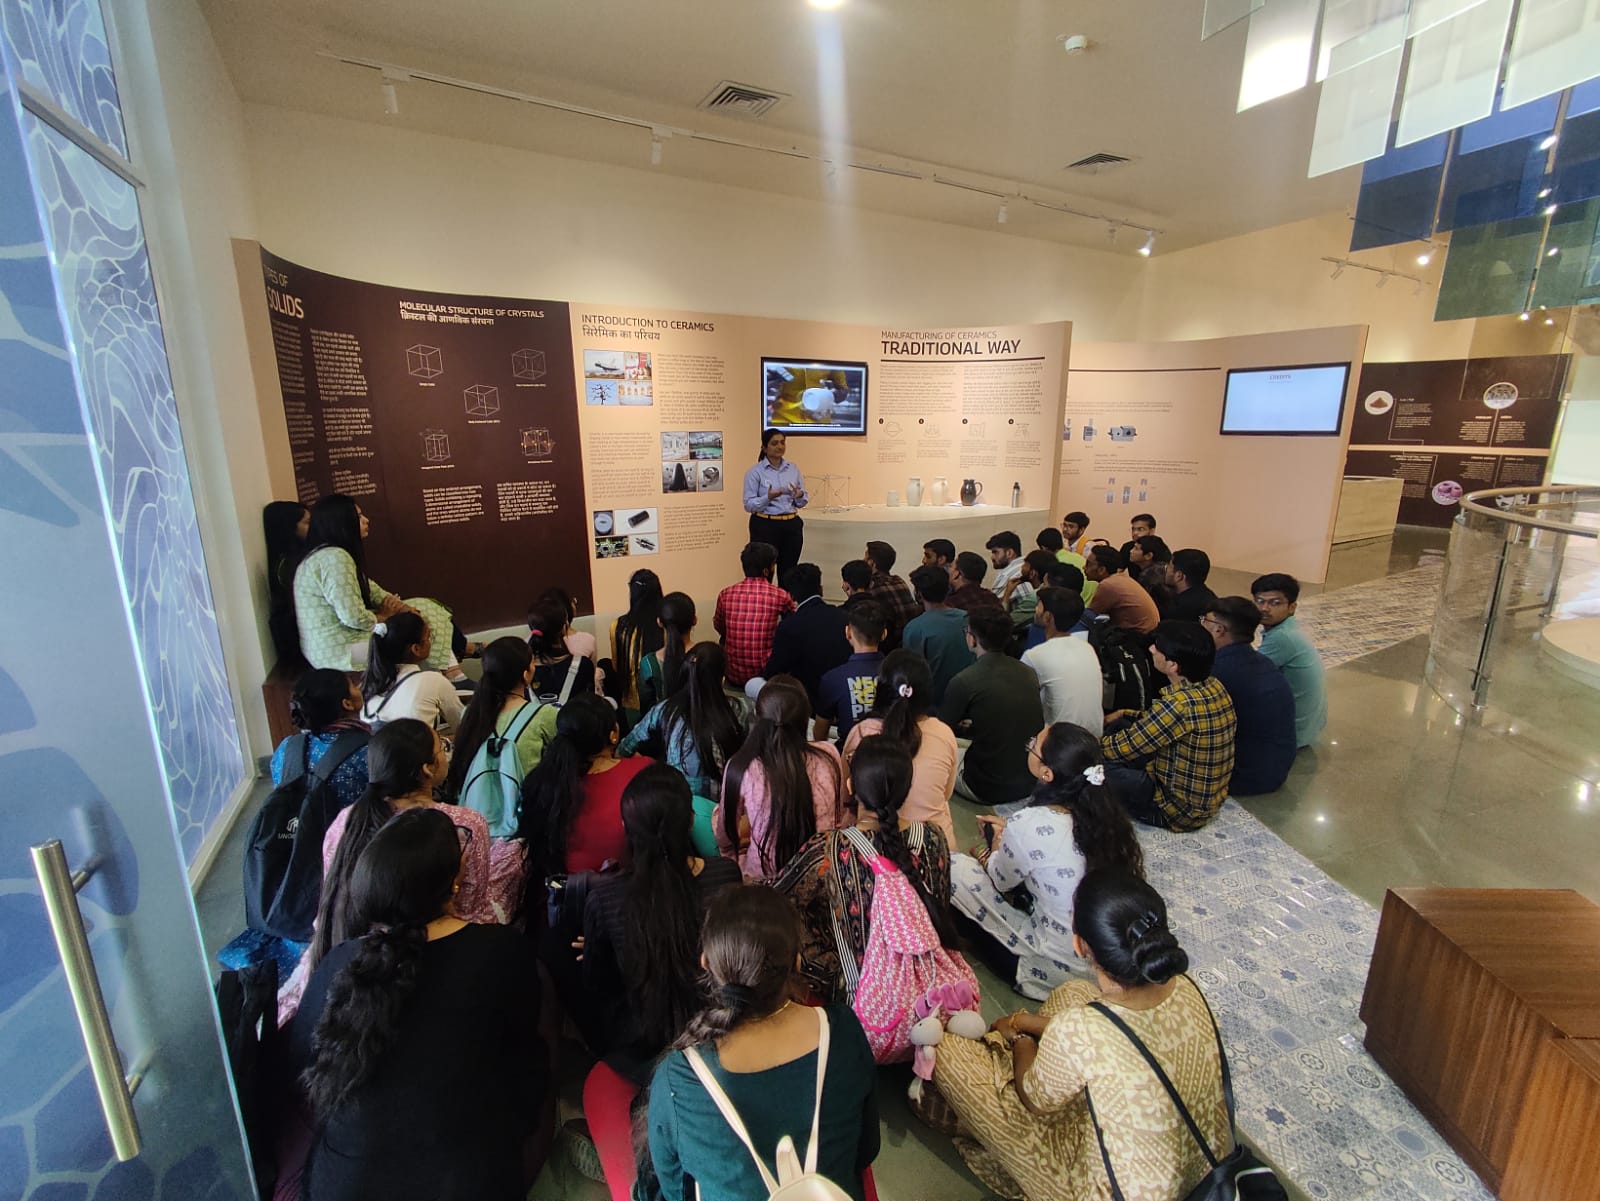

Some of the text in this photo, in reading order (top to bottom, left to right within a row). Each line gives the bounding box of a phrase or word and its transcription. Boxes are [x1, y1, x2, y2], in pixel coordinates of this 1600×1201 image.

[267, 286, 304, 319] SOLIDS
[399, 301, 446, 313] MOLECULAR
[448, 306, 494, 316] STRUCTURE
[507, 310, 544, 318] CRYSTALS
[581, 314, 715, 332] INTRODUCTION TO CERAMICS
[620, 329, 632, 339] का
[634, 328, 661, 340] परिचय
[881, 330, 997, 340] MANUFACTURING OF CERAMICS
[881, 339, 1021, 355] TRADITIONAL WAY
